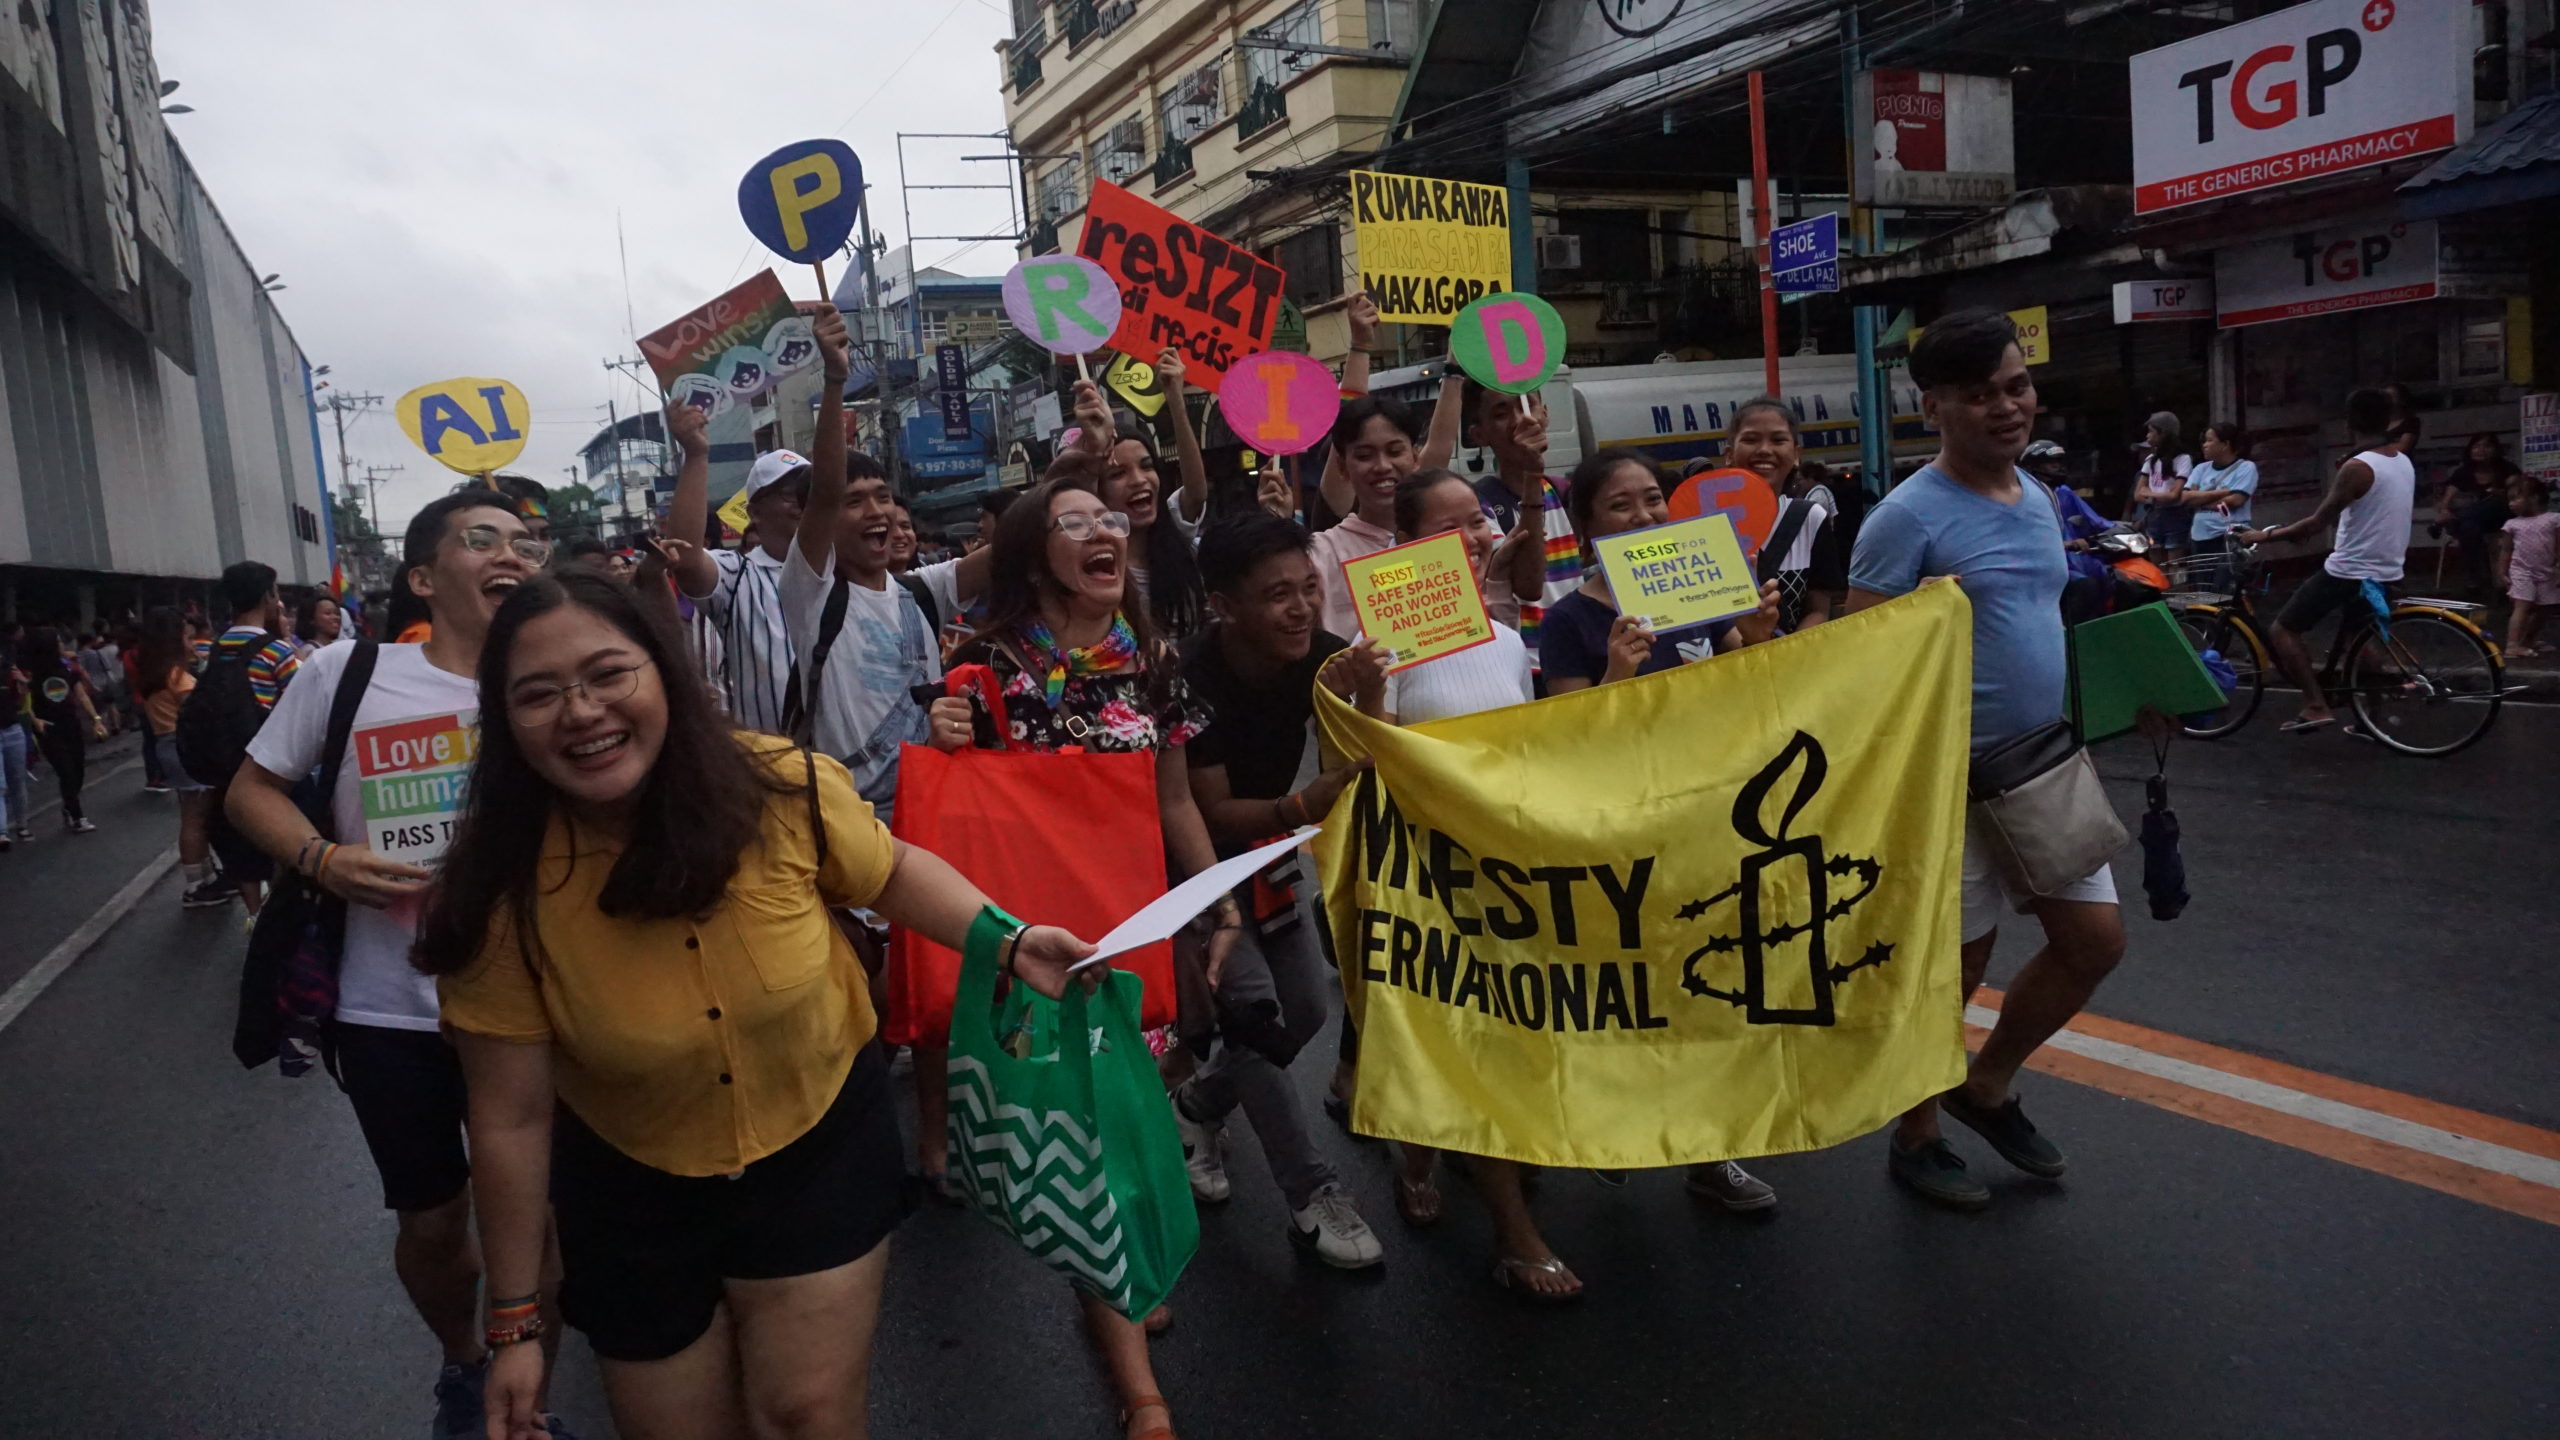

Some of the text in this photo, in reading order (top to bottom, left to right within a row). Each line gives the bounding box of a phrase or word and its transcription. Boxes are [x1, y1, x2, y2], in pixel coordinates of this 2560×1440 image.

[2177, 28, 2362, 144] TGP
[2163, 129, 2420, 202] THE GENERICS PHARMACY
[769, 152, 842, 252] P
[1354, 172, 1508, 228] RUMARAMPA
[1779, 232, 1816, 258] SHOE
[2293, 234, 2391, 286] TGP
[1815, 267, 1835, 282] PAZ
[1022, 263, 1109, 341] R
[2153, 287, 2186, 306] TGP
[2307, 297, 2358, 312] GENERICS
[2359, 287, 2420, 306] PHARMACY
[642, 300, 733, 360] Love
[1478, 299, 1547, 385] D
[420, 386, 521, 455] AI
[1256, 362, 1301, 440] I
[1651, 394, 1829, 434] MARNA
[1624, 538, 1707, 562] RESIST FOR
[1631, 552, 1716, 581] MENTAL
[1367, 569, 1461, 608] SAFE SPACES
[1369, 561, 1444, 588] RESIST FOR
[1641, 567, 1723, 597] HEALTH
[1374, 585, 1463, 621] FOR WOMEN
[1392, 601, 1459, 633] AND LGBT
[369, 734, 450, 770] Love
[376, 774, 469, 812] huma
[382, 824, 435, 851] PASS
[1352, 768, 1656, 950] MESTY
[1361, 908, 1669, 1033] ERNATIONAL
